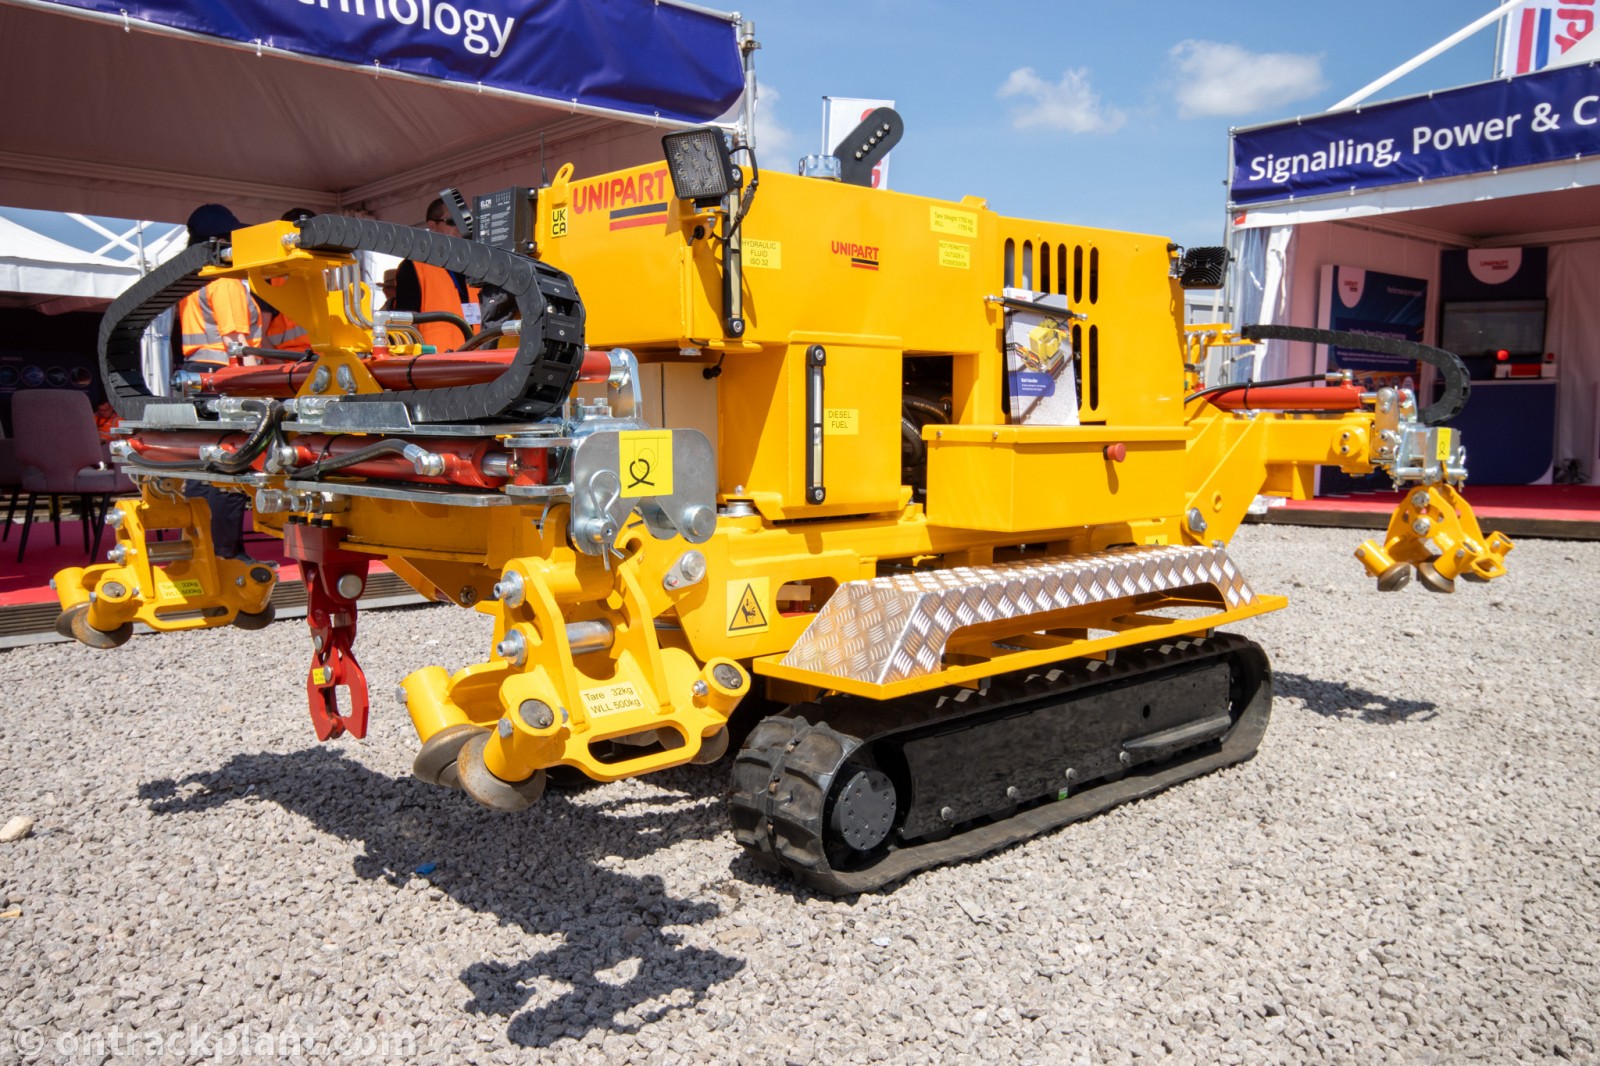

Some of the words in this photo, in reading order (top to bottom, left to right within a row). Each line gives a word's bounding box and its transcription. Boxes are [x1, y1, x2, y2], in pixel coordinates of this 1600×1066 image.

[1249, 138, 1401, 183] Signalling,
[1412, 113, 1522, 155] Power
[1531, 102, 1561, 132] &
[1572, 95, 1600, 126] C
[573, 169, 667, 215] UNIPART
[552, 209, 566, 222] UK
[552, 222, 566, 235] CA
[742, 240, 776, 250] HYDRAULIC
[831, 240, 879, 260] UNIPART
[750, 249, 768, 258] FLUID
[828, 410, 852, 419] DIESEL
[831, 420, 848, 429] FUEL
[584, 692, 605, 702] Tare
[610, 687, 634, 697] 32kg
[590, 702, 613, 714] WLL
[612, 699, 642, 710] 500kg
